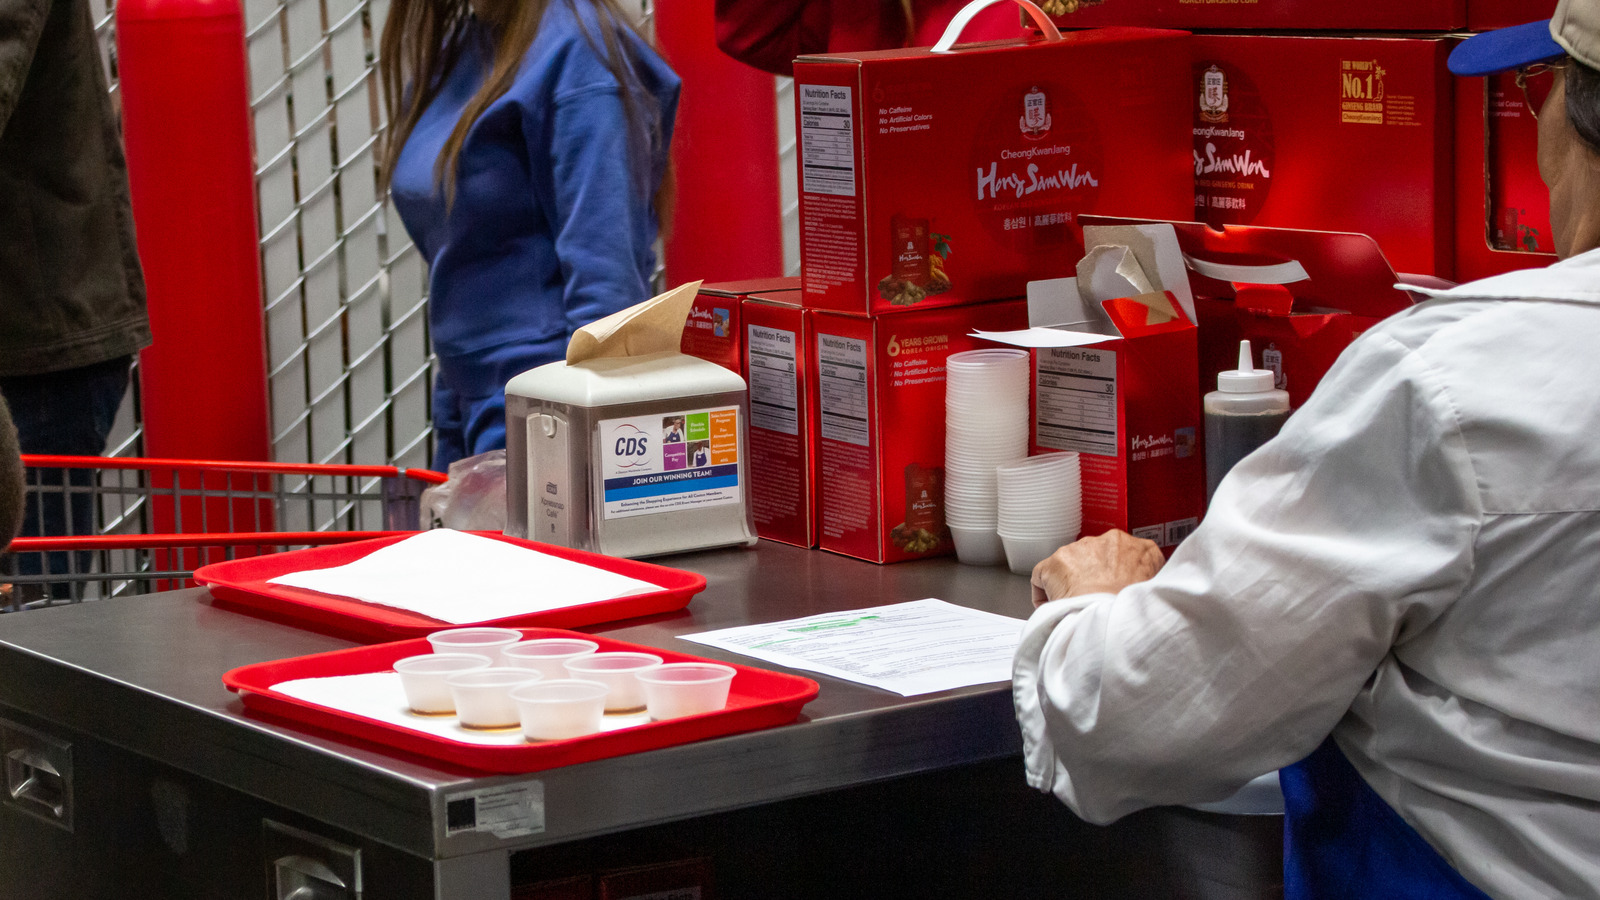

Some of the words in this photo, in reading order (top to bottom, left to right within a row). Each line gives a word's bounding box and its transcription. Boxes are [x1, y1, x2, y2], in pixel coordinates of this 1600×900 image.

[1342, 73, 1373, 99] No.1
[804, 89, 830, 98] Nutrition
[830, 90, 846, 100] Facts
[1364, 103, 1383, 112] BRAND
[889, 115, 913, 124] Artificial
[890, 124, 930, 133] Preservatives
[1193, 127, 1244, 140] eongKwanJang
[1001, 145, 1070, 160] CheongKwanJang
[1237, 182, 1254, 190] DRINK
[753, 329, 776, 340] Nutrition
[776, 333, 790, 344] Facts
[823, 338, 846, 349] Nutrition
[846, 342, 862, 352] Facts
[887, 334, 900, 357] 6
[901, 338, 922, 348] YEARS
[923, 335, 948, 346] GROWN
[1051, 348, 1080, 360] Nutrition
[1082, 352, 1100, 362] Facts
[904, 368, 928, 376] Artificial
[1106, 384, 1114, 392] 30
[615, 437, 648, 456] CDS
[664, 472, 692, 481] WINNING
[693, 470, 712, 478] TEAM!
